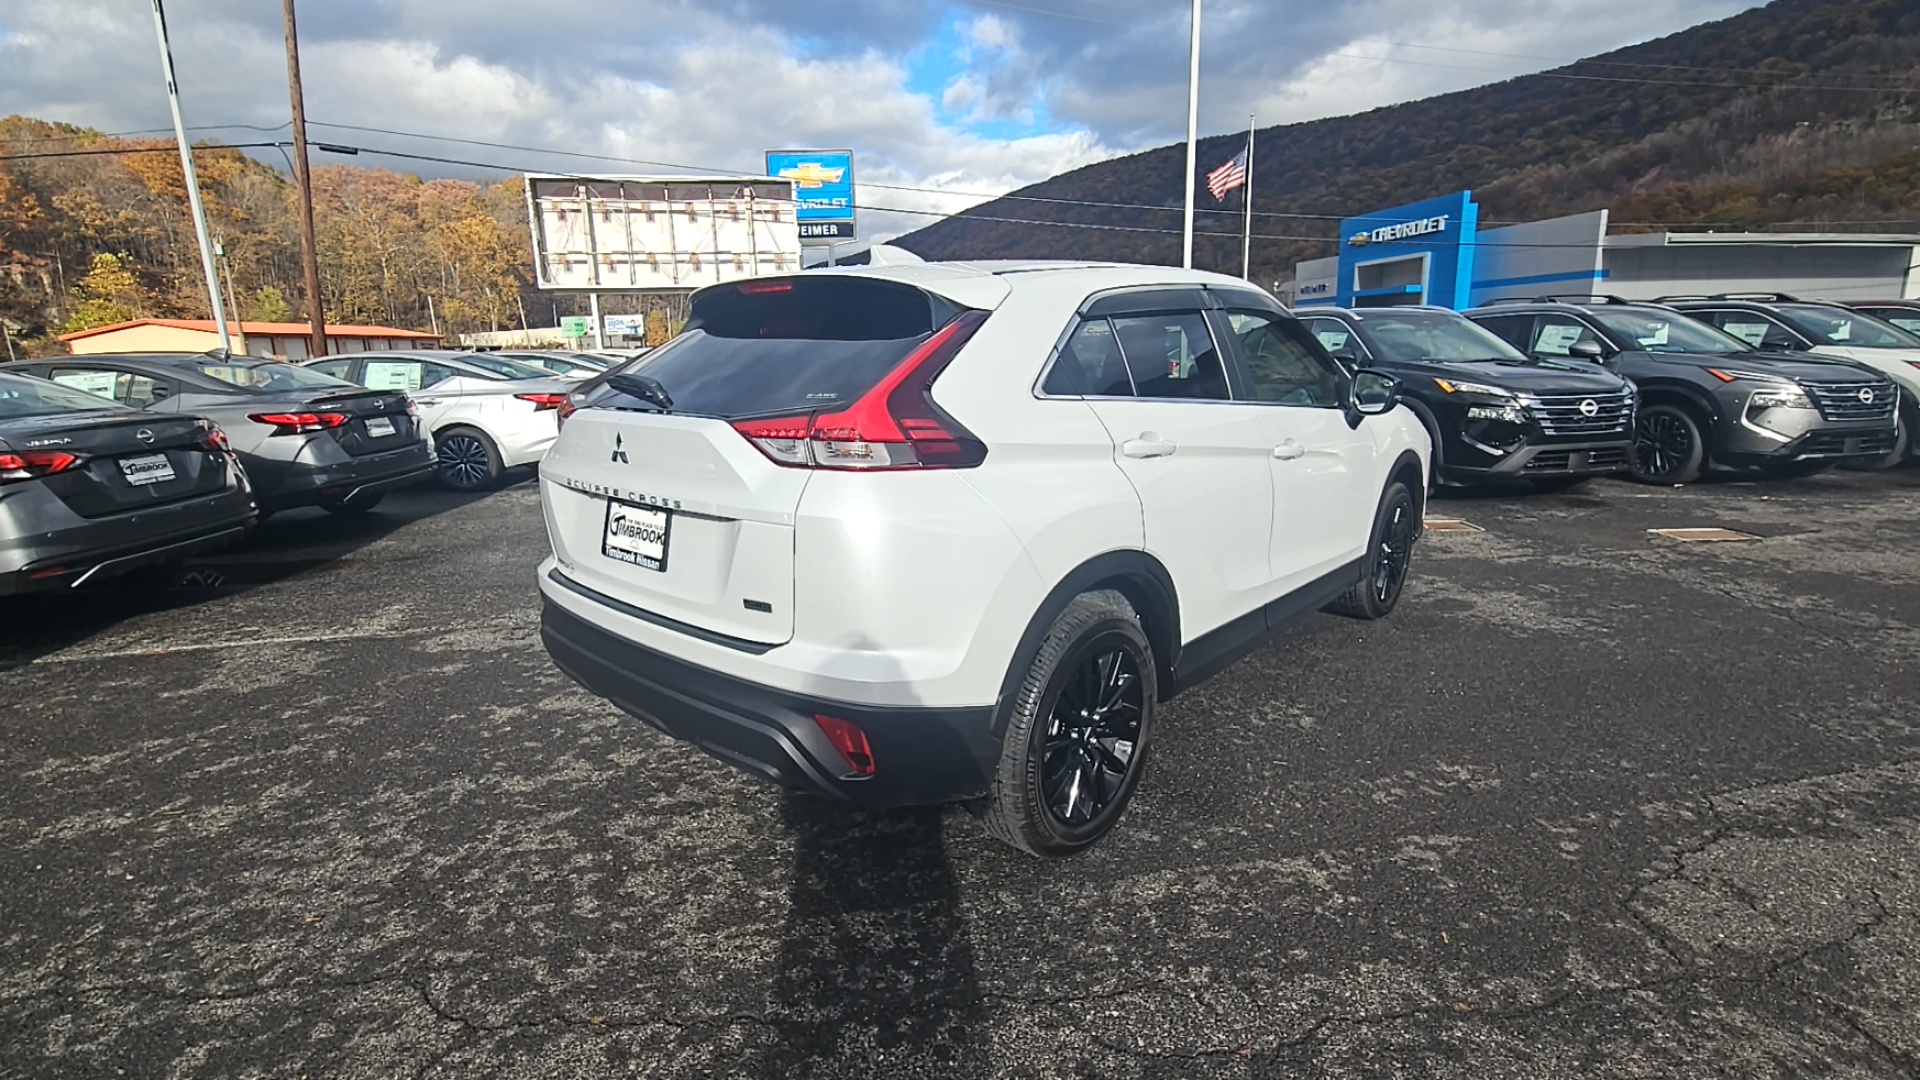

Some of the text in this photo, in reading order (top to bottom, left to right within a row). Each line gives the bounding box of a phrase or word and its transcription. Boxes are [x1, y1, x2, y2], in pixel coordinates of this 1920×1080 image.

[796, 197, 848, 209] EVROLET
[1371, 214, 1449, 242] CHEVROLET
[566, 478, 682, 509] ECLIPSE CROSS
[610, 511, 666, 546] TIMBROOK
[606, 545, 660, 571] Timbrook Nissan
